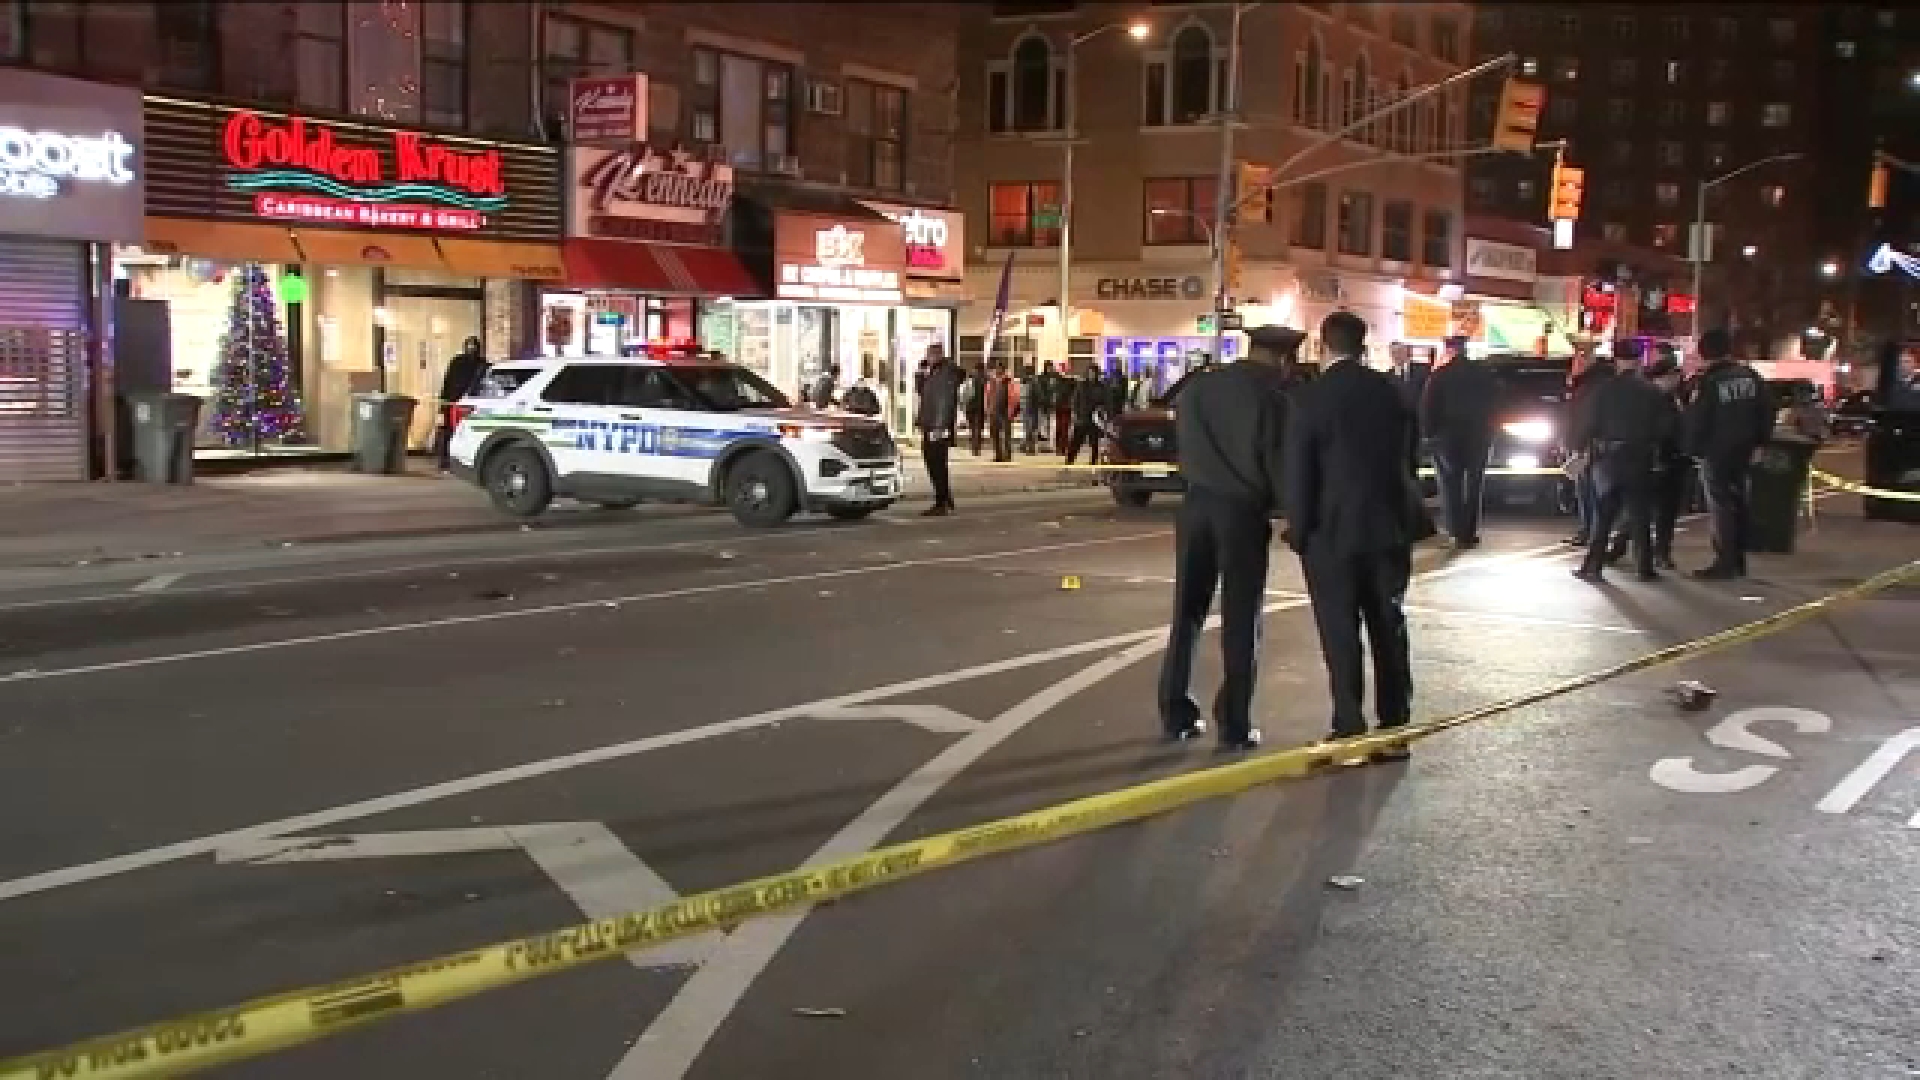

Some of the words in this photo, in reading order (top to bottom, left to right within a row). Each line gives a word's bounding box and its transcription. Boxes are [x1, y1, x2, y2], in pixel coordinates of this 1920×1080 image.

[222, 110, 384, 182] Golden
[394, 132, 505, 194] Krust
[584, 148, 734, 222] Kennedy
[1097, 278, 1178, 300] CHASE
[575, 419, 660, 456] NYPD
